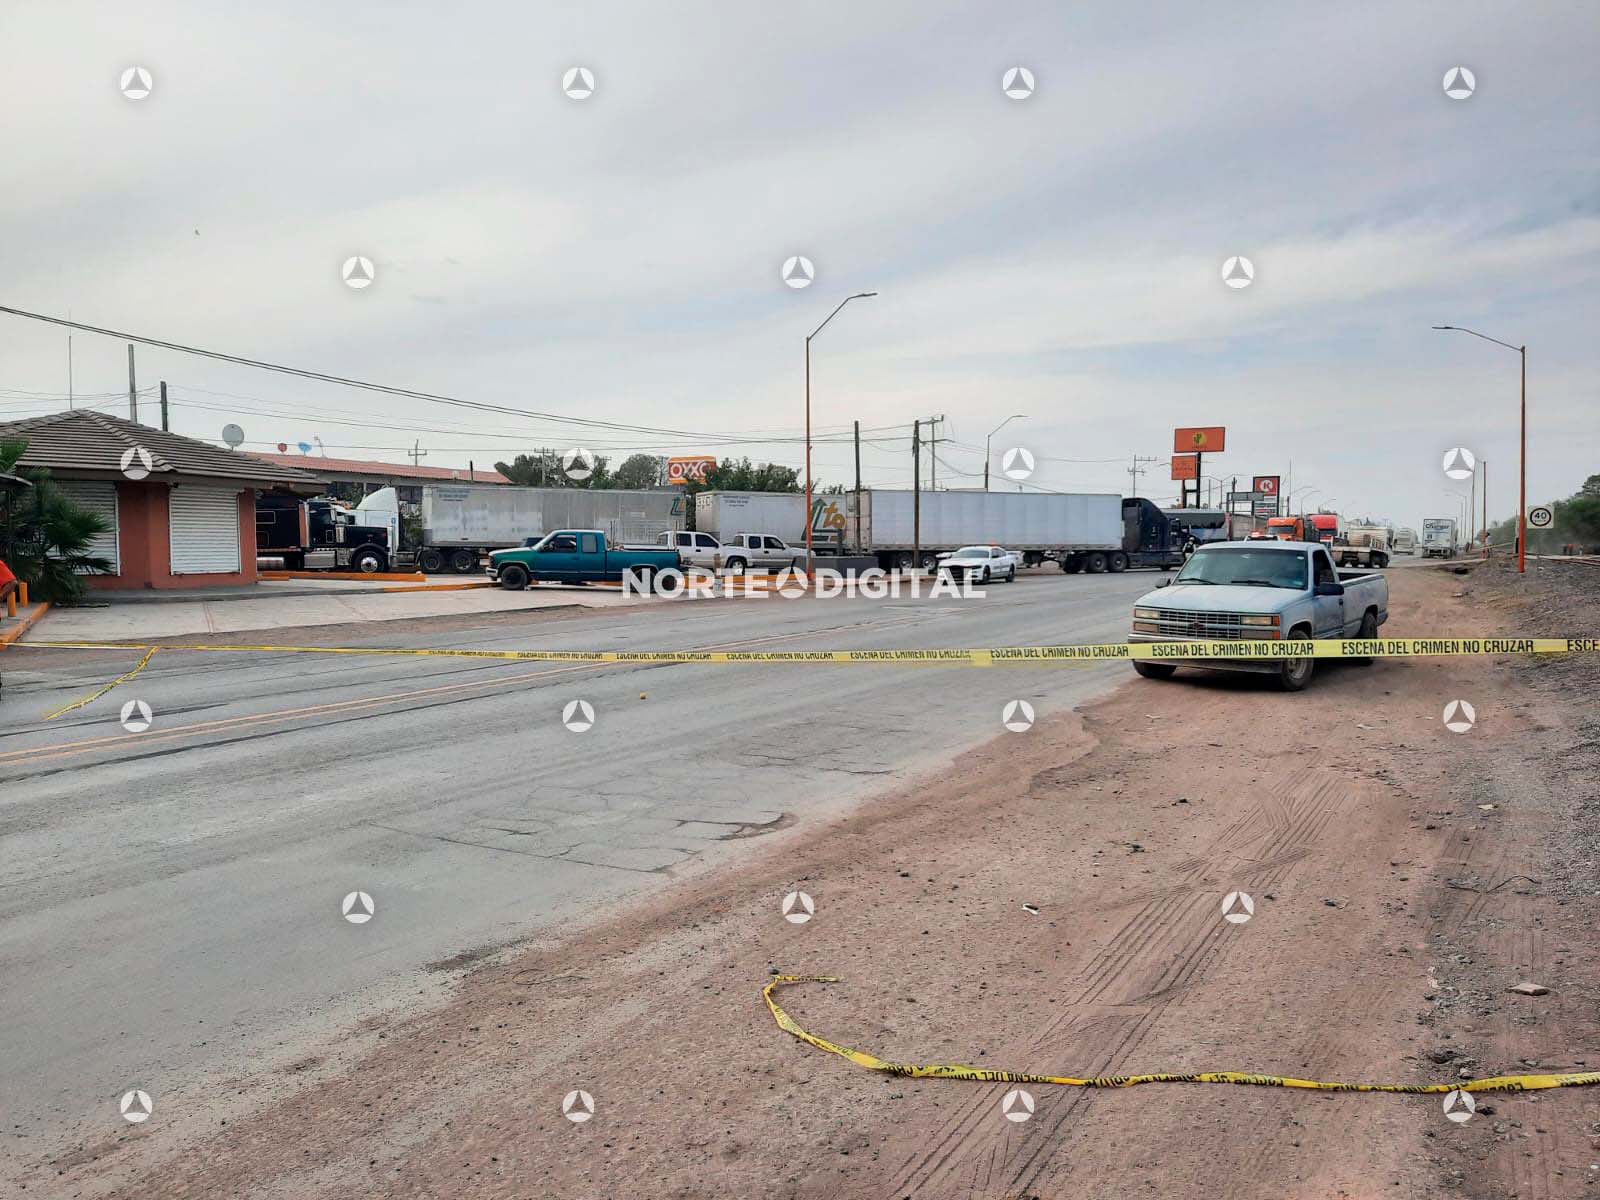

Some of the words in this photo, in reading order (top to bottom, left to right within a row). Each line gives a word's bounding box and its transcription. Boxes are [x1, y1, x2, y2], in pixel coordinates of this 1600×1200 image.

[991, 648, 1023, 658] ESCENA
[1024, 648, 1040, 658] DEL
[1042, 647, 1076, 658] CRIMEN
[1078, 646, 1090, 657] NO
[1093, 645, 1129, 657] CRUZAR
[1152, 644, 1189, 657] ESCENA
[1191, 644, 1210, 656] DEL
[1213, 643, 1251, 656] CRIMEN
[1254, 643, 1269, 656] NO
[1272, 642, 1314, 655] CRUZAR
[1342, 641, 1385, 655] ESCENA
[1388, 641, 1409, 654] DEL
[1412, 640, 1460, 654] CRIMEN
[1463, 640, 1480, 653] NO
[1483, 639, 1534, 653] CRUZAR
[1566, 639, 1600, 652] ESCE
